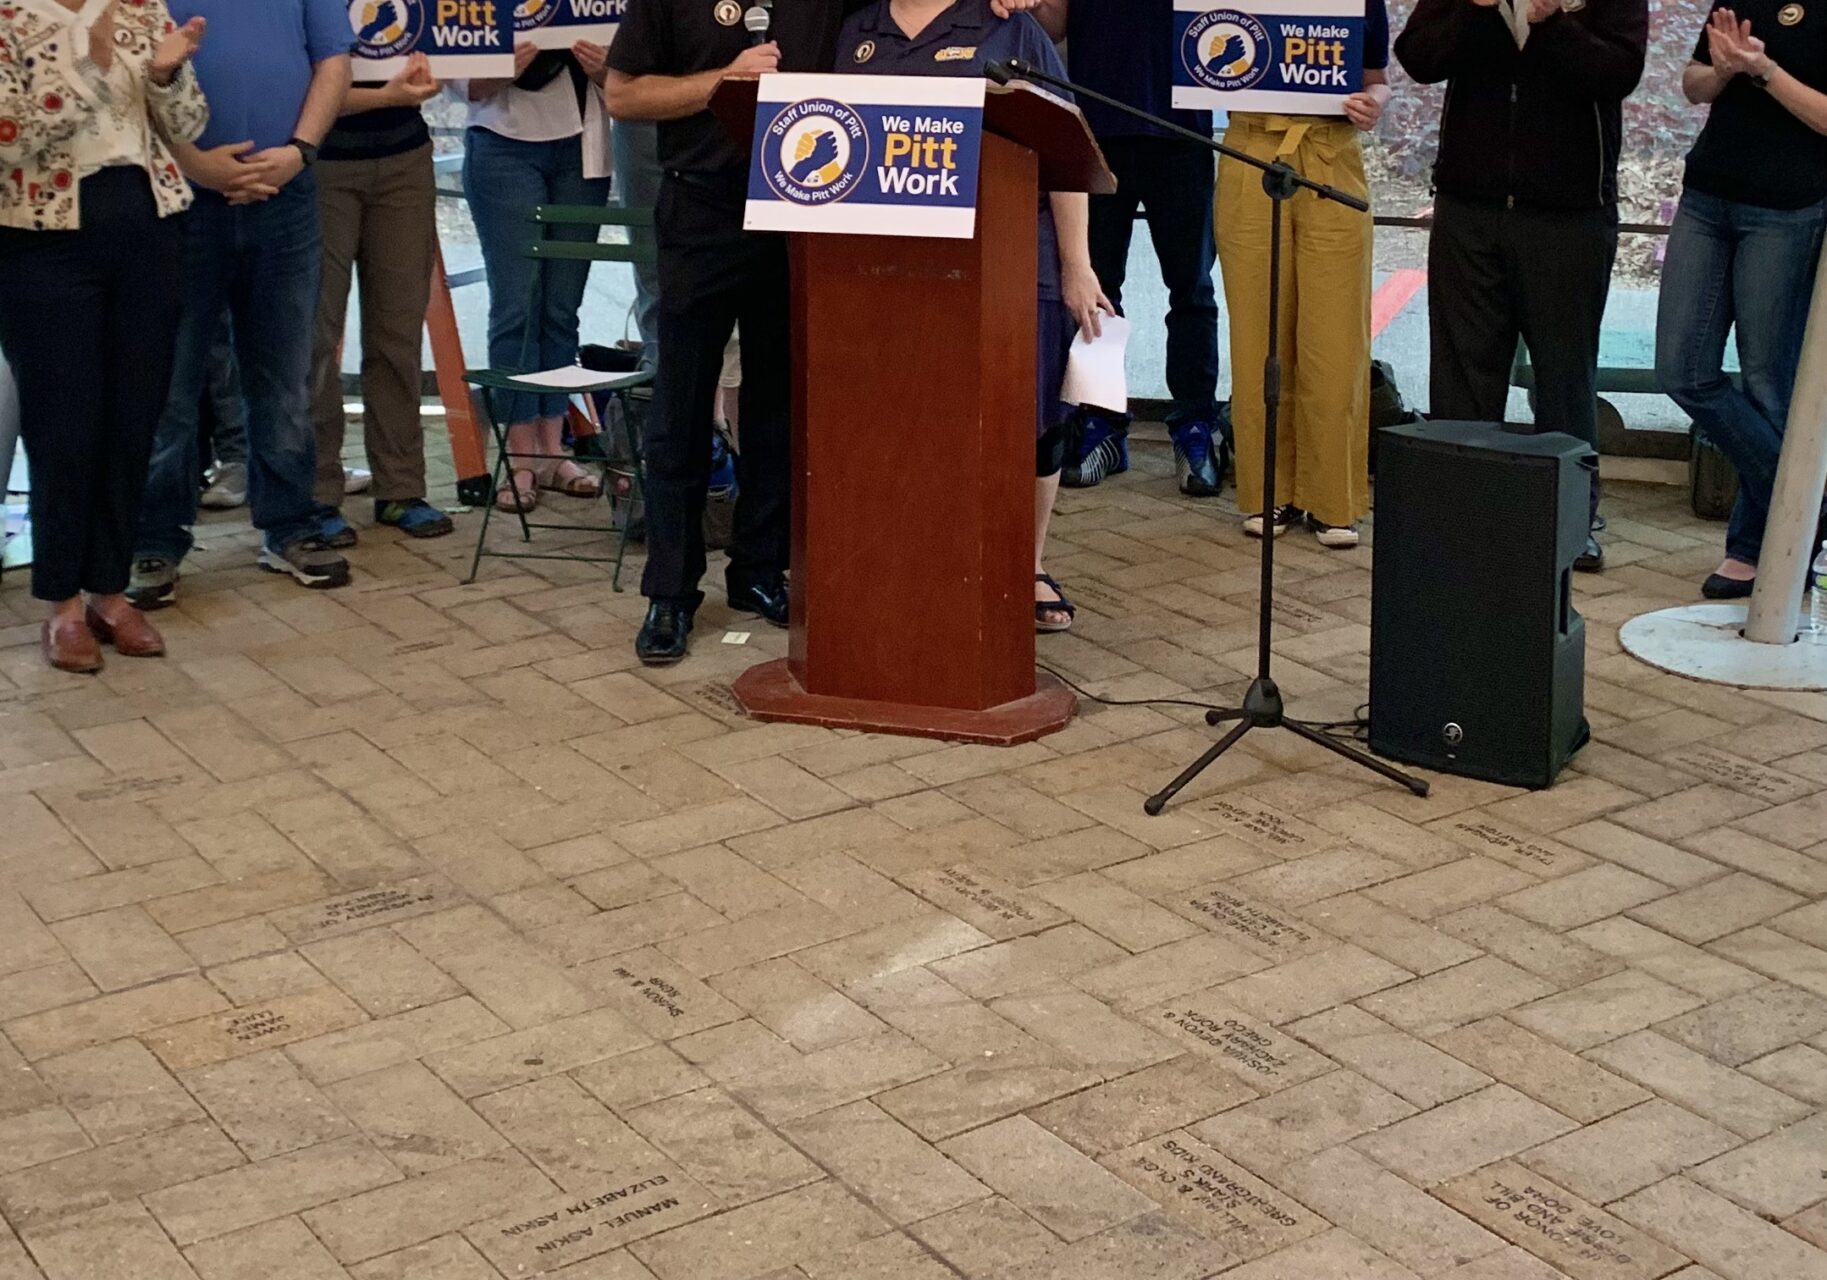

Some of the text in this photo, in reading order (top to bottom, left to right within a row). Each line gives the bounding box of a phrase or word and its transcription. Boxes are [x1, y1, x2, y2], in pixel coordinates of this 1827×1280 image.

[437, 0, 497, 26] Pitt
[432, 25, 500, 47] Work
[1188, 13, 1265, 42] Staff Union of Pitt
[1280, 24, 1349, 38] We Make
[1285, 38, 1345, 66] Pitt
[1194, 64, 1206, 79] We
[1203, 75, 1225, 88] Make
[1227, 78, 1242, 88] Pitt
[1240, 67, 1260, 84] Work
[1279, 63, 1348, 86] Work
[772, 101, 863, 139] Staff Union of Pitt
[882, 116, 964, 134] We Make
[885, 133, 957, 169] Pitt
[774, 171, 787, 189] We
[786, 184, 811, 201] Make
[812, 190, 829, 201] Pitt
[828, 172, 853, 194] Work
[877, 167, 959, 195] Work
[236, 1023, 290, 1041] OWEN
[1173, 1019, 1225, 1046] DEVON
[1181, 1009, 1287, 1067] ZACHARY ROCK
[1221, 1019, 1274, 1046] GRECO
[1220, 1045, 1279, 1077] JOSHUA
[1157, 1140, 1201, 1163] KIDS
[1131, 1156, 1179, 1183] OLGA
[1173, 1184, 1195, 1193] &
[1485, 1180, 1526, 1203] BILL
[1520, 1184, 1574, 1215] DORA
[500, 1173, 668, 1239] ELIZABETH ASKIN
[1523, 1202, 1566, 1225] AND
[534, 1195, 679, 1255] MANUEL ASKIN
[1479, 1192, 1603, 1262] IN HONOR OF
